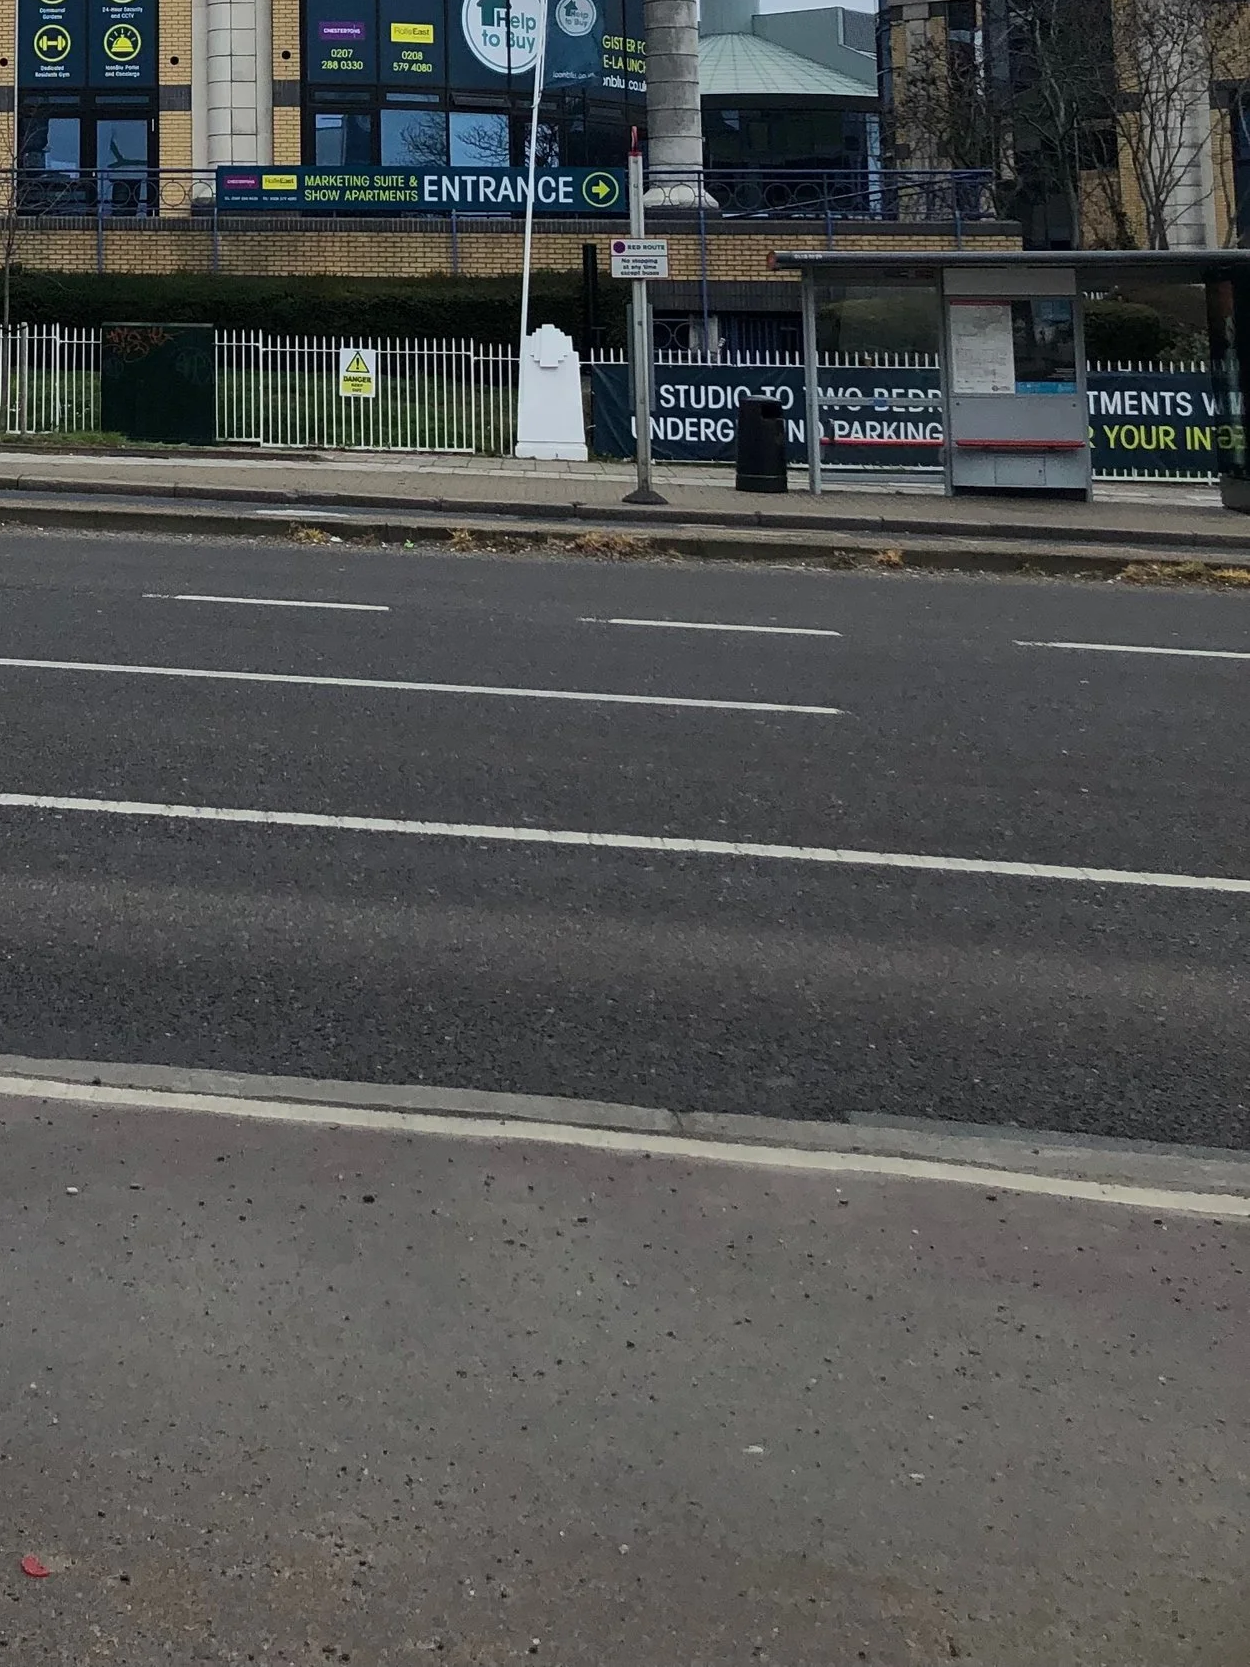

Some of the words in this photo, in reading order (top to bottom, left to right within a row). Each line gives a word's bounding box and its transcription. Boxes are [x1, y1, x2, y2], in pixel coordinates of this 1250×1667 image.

[496, 10, 537, 33] Help
[481, 29, 500, 47] to
[331, 49, 354, 57] 0207
[401, 51, 423, 60] 0208
[321, 61, 338, 69] 288
[340, 61, 364, 70] 0330
[393, 62, 409, 71] 579
[410, 63, 432, 72] 4080
[304, 175, 369, 187] MARKETING
[373, 176, 406, 187] SUITE
[408, 176, 418, 187] &
[304, 189, 340, 201] SHOW
[344, 189, 418, 202] APARTMENTS
[423, 175, 573, 203] ENTRANCE
[343, 375, 372, 383] DANGER
[1086, 390, 1193, 417] TMENTS
[834, 419, 944, 441] PARKING
[1102, 425, 1179, 450] YOUR
